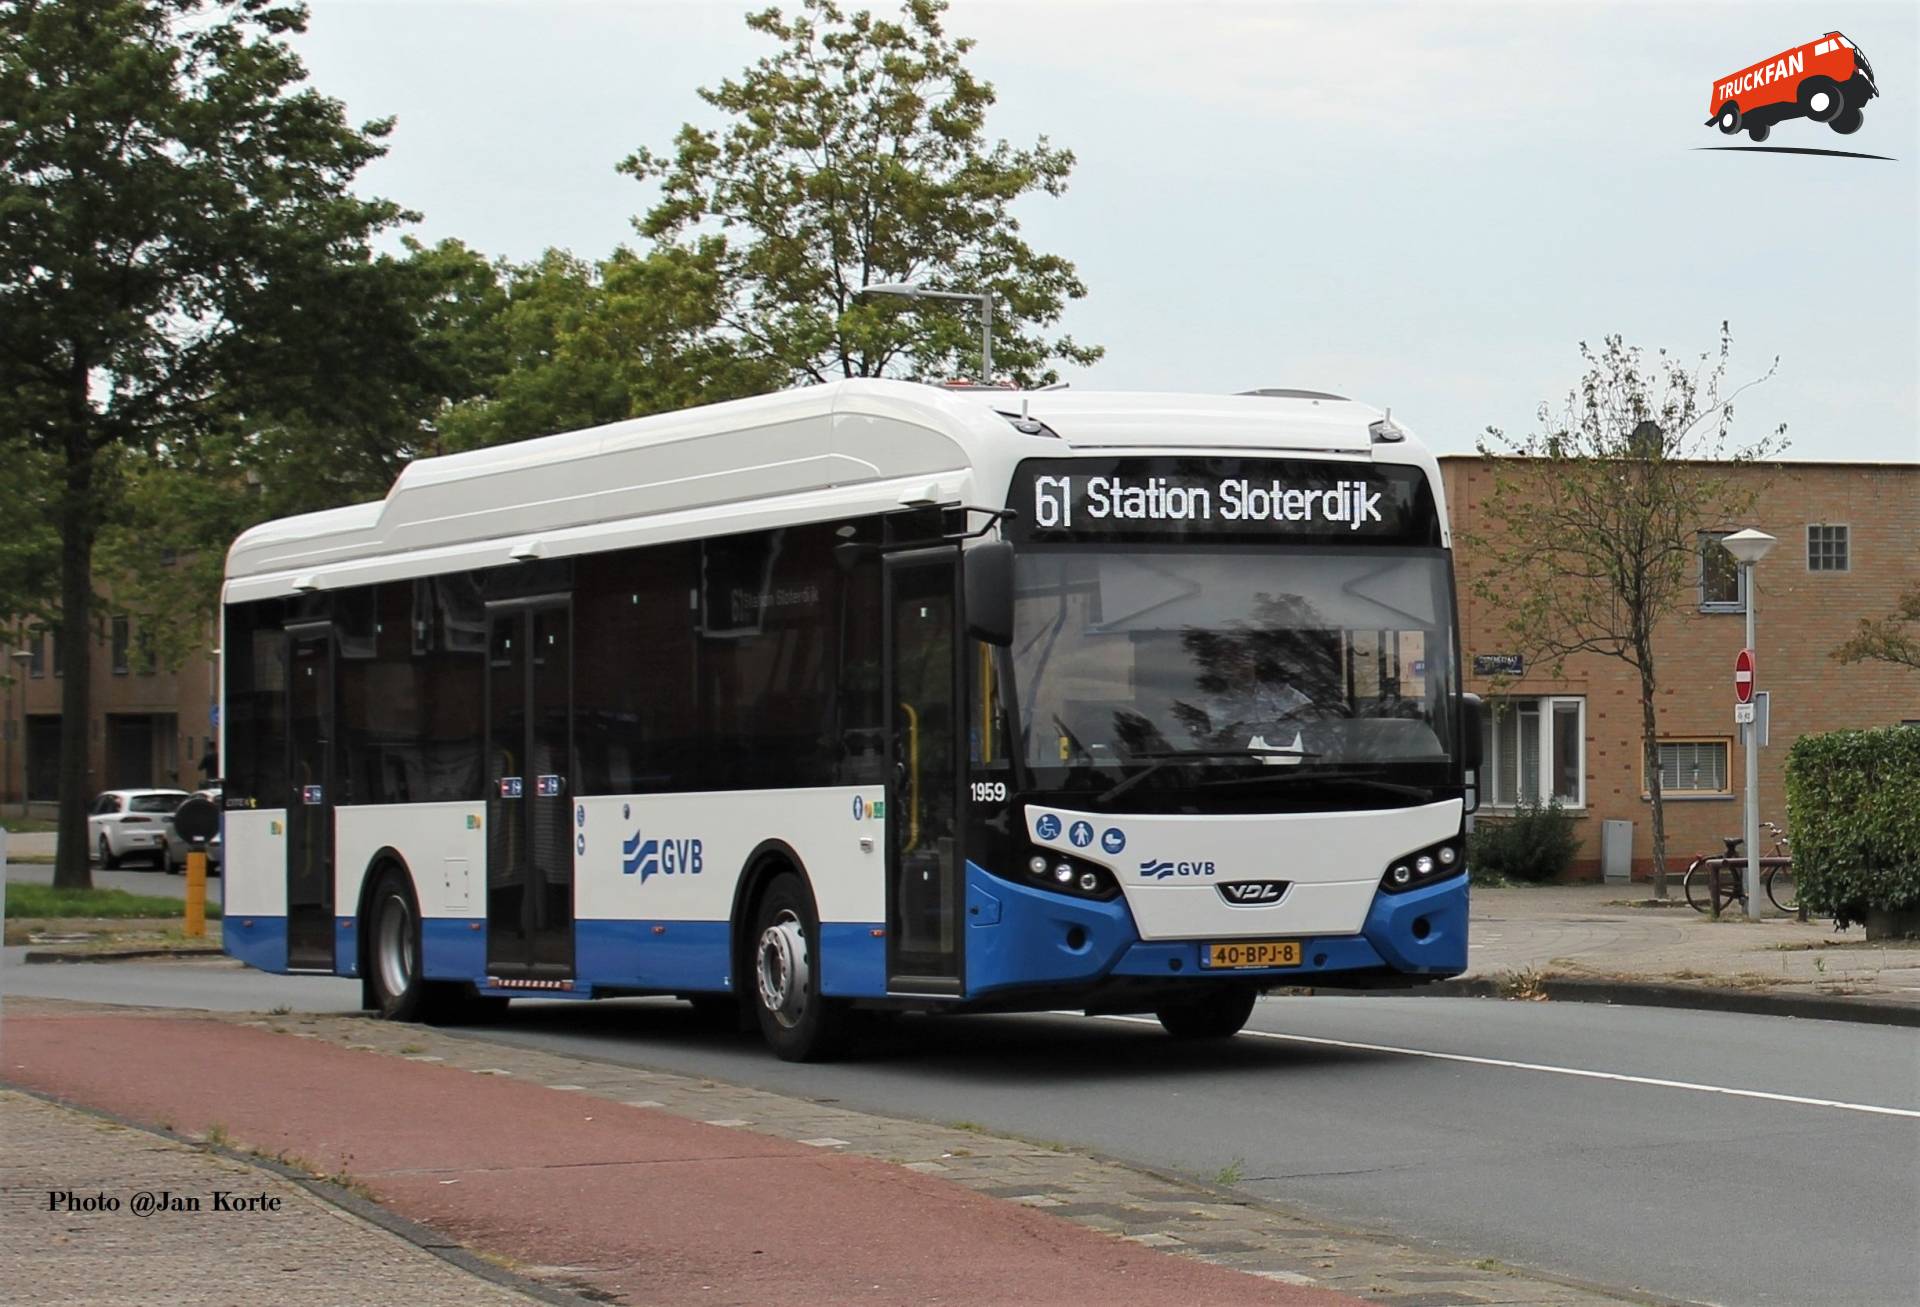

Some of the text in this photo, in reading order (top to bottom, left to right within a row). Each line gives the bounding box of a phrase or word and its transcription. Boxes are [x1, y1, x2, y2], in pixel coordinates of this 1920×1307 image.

[1035, 475, 1382, 530] 61 Station Sloterdijk
[970, 782, 1006, 801] 1959
[661, 838, 703, 875] GVB
[1177, 862, 1216, 876] GVB
[1227, 884, 1278, 899] VDL
[1216, 945, 1294, 963] 40-BPJ-8
